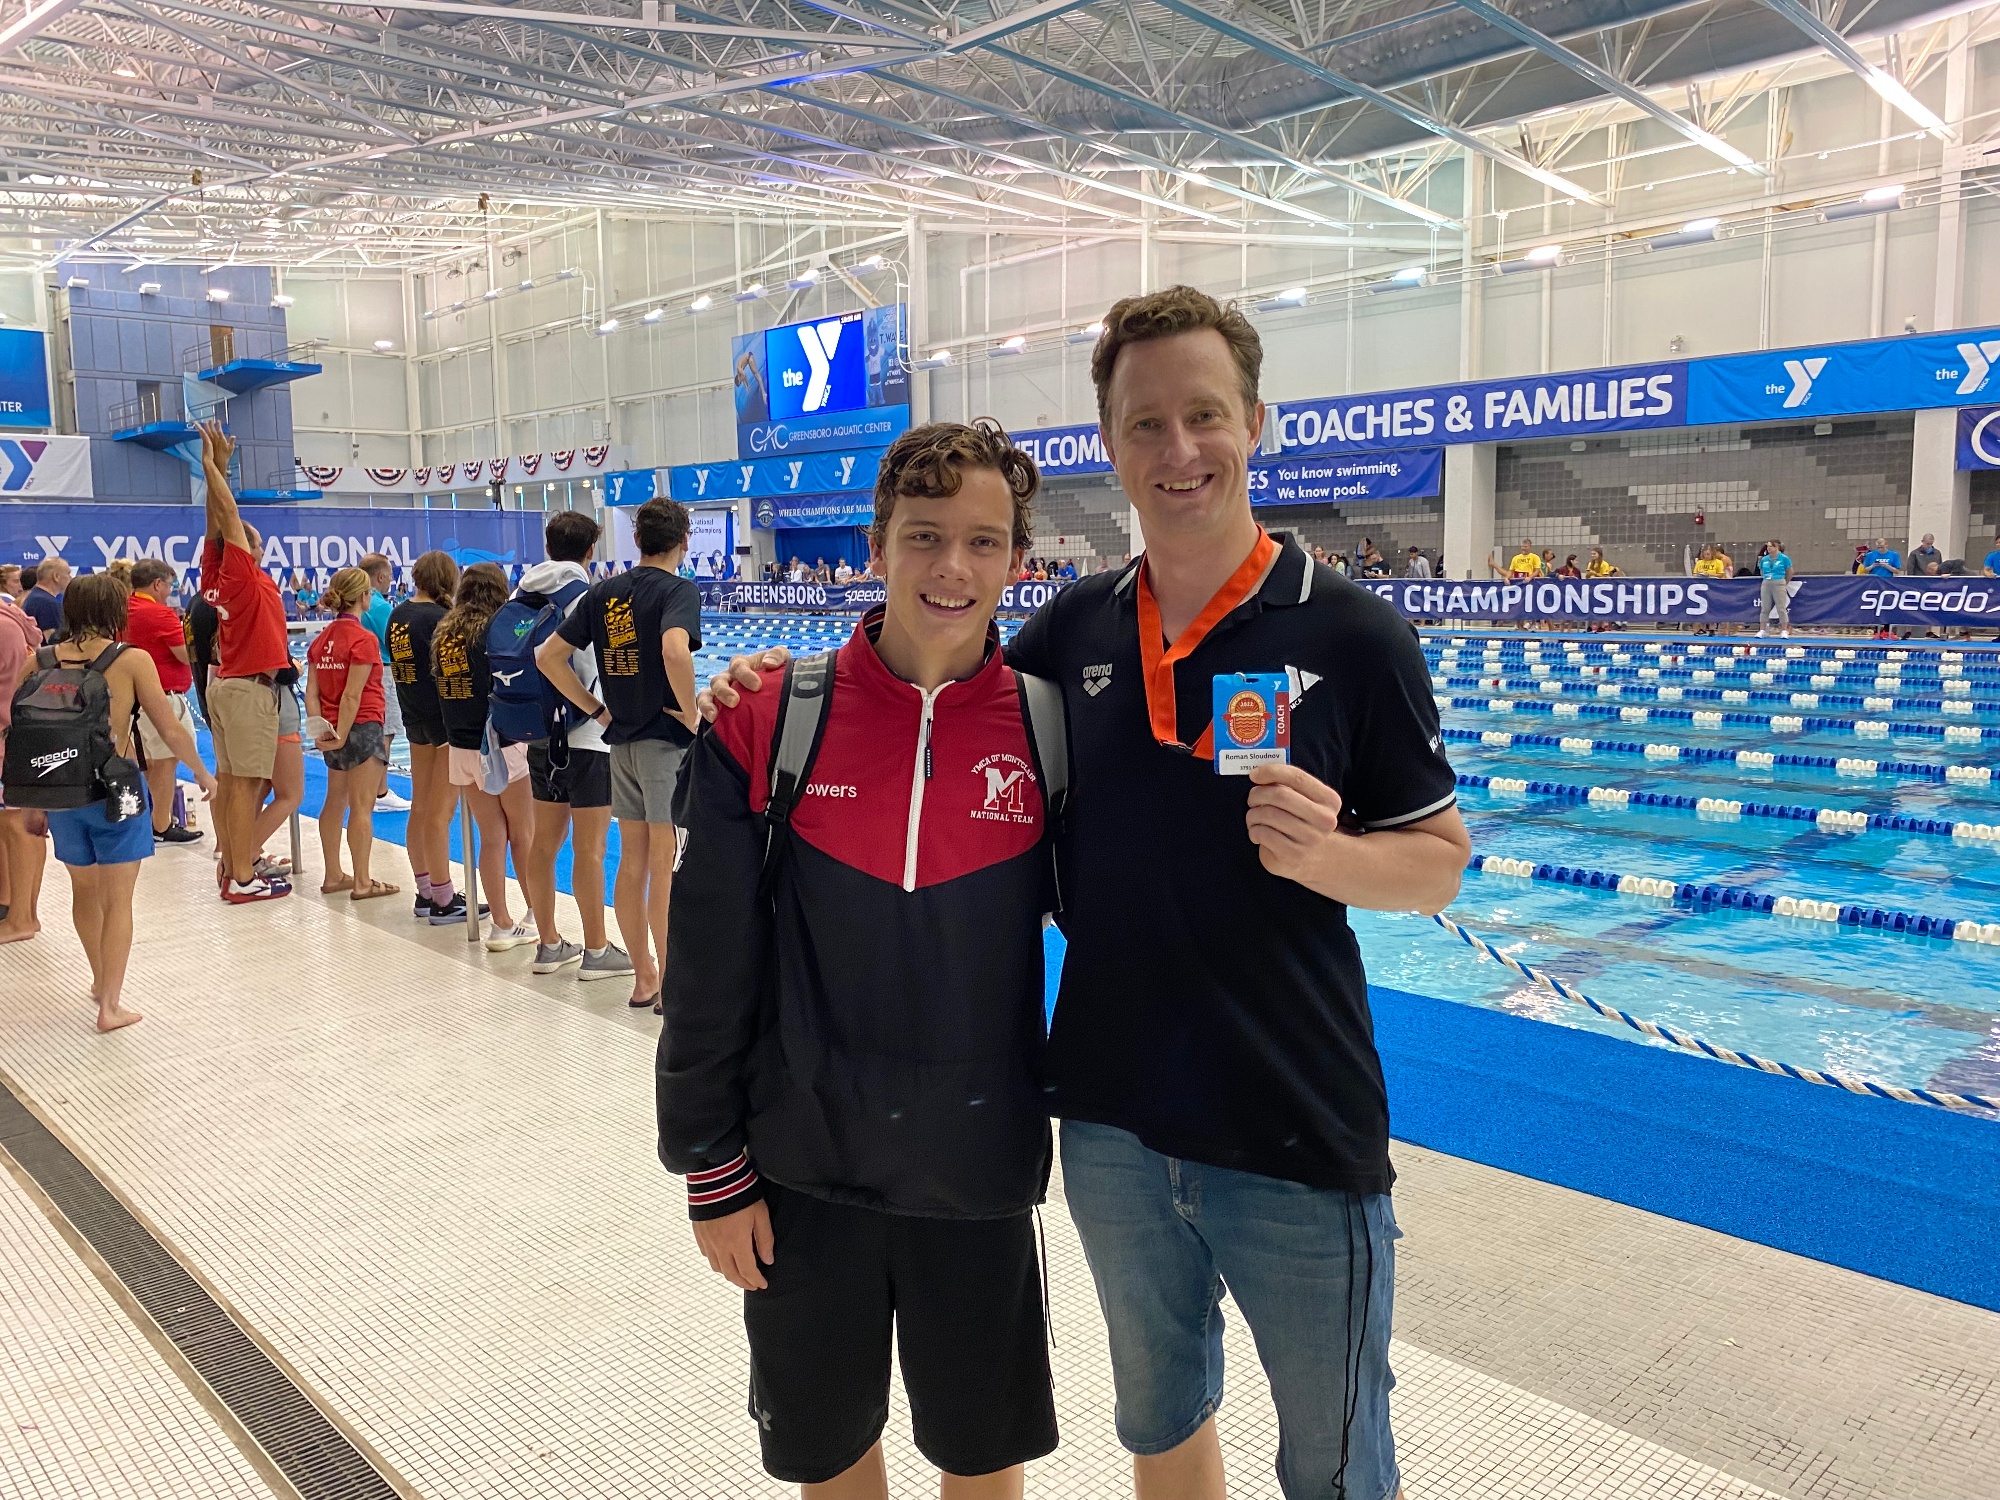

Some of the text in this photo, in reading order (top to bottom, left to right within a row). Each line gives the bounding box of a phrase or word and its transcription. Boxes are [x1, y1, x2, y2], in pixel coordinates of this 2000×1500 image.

[879, 330, 904, 345] T.WAE
[782, 368, 803, 387] the
[1935, 368, 1959, 380] the
[1765, 384, 1785, 395] the
[1977, 378, 1990, 392] YMCA
[1279, 374, 1673, 447] COACHES & FAMILIES
[788, 427, 832, 442] GREENSBORO
[833, 424, 863, 437] AQUATIC
[864, 422, 892, 433] CENTER
[1014, 433, 1111, 468] ELCOM
[1278, 461, 1401, 481] You know swimming.
[1277, 482, 1370, 500] We know pools.
[778, 508, 800, 518] WHERE
[802, 506, 841, 516] CHAMPIONS
[842, 506, 854, 514] ARE
[856, 504, 876, 513] MADE
[23, 552, 39, 560] the
[260, 536, 419, 569] ATIONAL
[735, 585, 827, 606] GREENSBORO
[845, 587, 886, 605] speedo
[1020, 585, 1061, 608] COU
[1403, 583, 1709, 616] CHAMPIONSHIPS
[1753, 598, 1763, 607] th
[1860, 585, 1989, 617] speedo
[1082, 663, 1113, 679] arena
[1277, 704, 1285, 734] COACH
[30, 748, 78, 768] speedo
[1225, 752, 1280, 761] Roman Sloudnov
[971, 754, 1037, 782] YMCA OF MONTCLAIR
[805, 783, 858, 798] owers
[983, 767, 1025, 813] M
[970, 810, 1034, 824] NATIONAL TEAM
